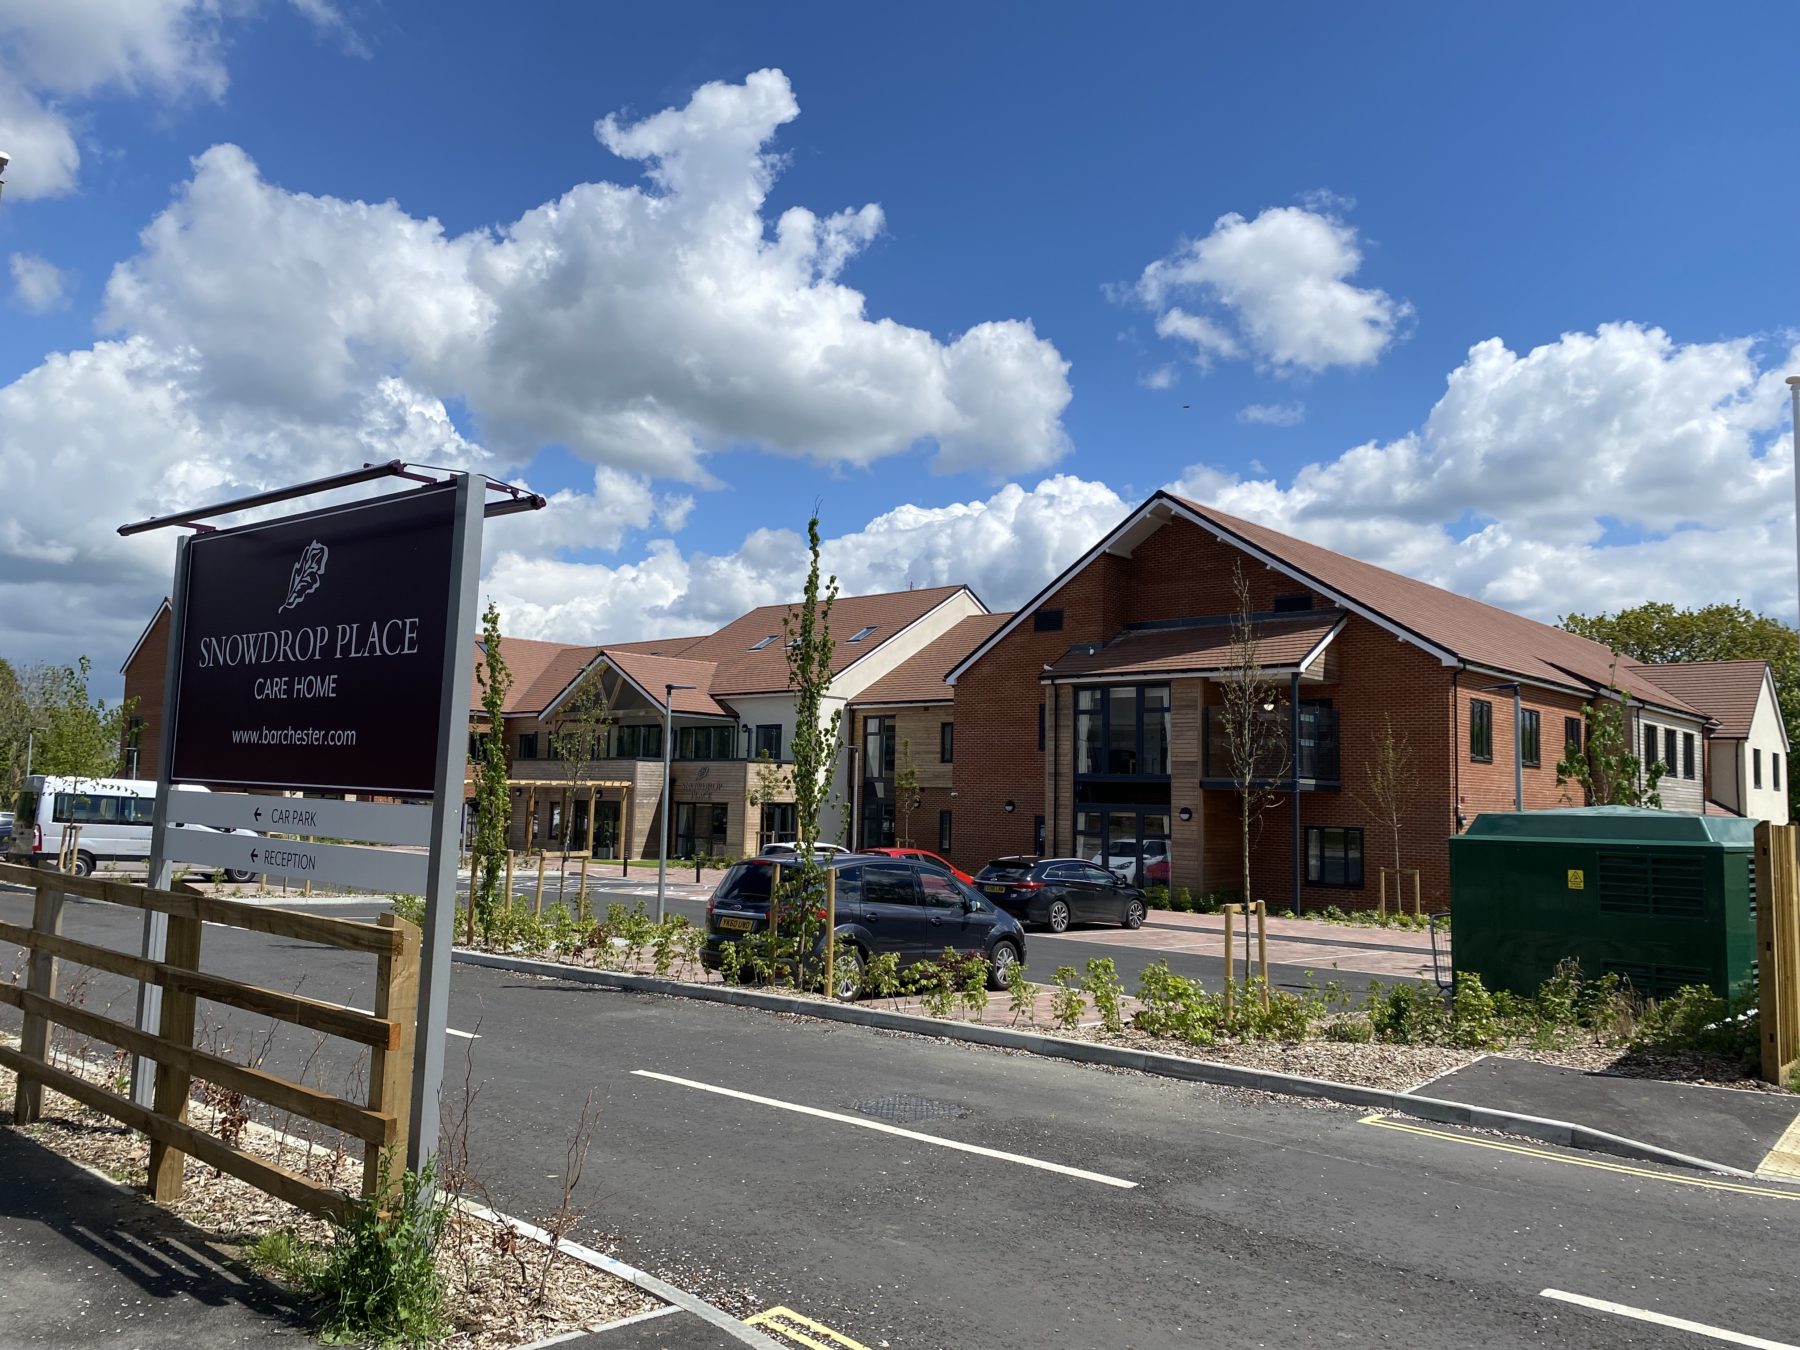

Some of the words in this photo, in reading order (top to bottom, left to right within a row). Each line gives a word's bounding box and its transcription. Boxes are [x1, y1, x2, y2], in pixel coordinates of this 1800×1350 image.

[199, 626, 329, 667] SNOWDROP
[335, 618, 419, 658] PLACE
[254, 677, 288, 699] CARE
[293, 674, 338, 698] HOME
[232, 725, 356, 746] www.barchester.com
[271, 808, 290, 824] CAR
[292, 810, 317, 827] PARK
[263, 849, 316, 870] RECEPTION
